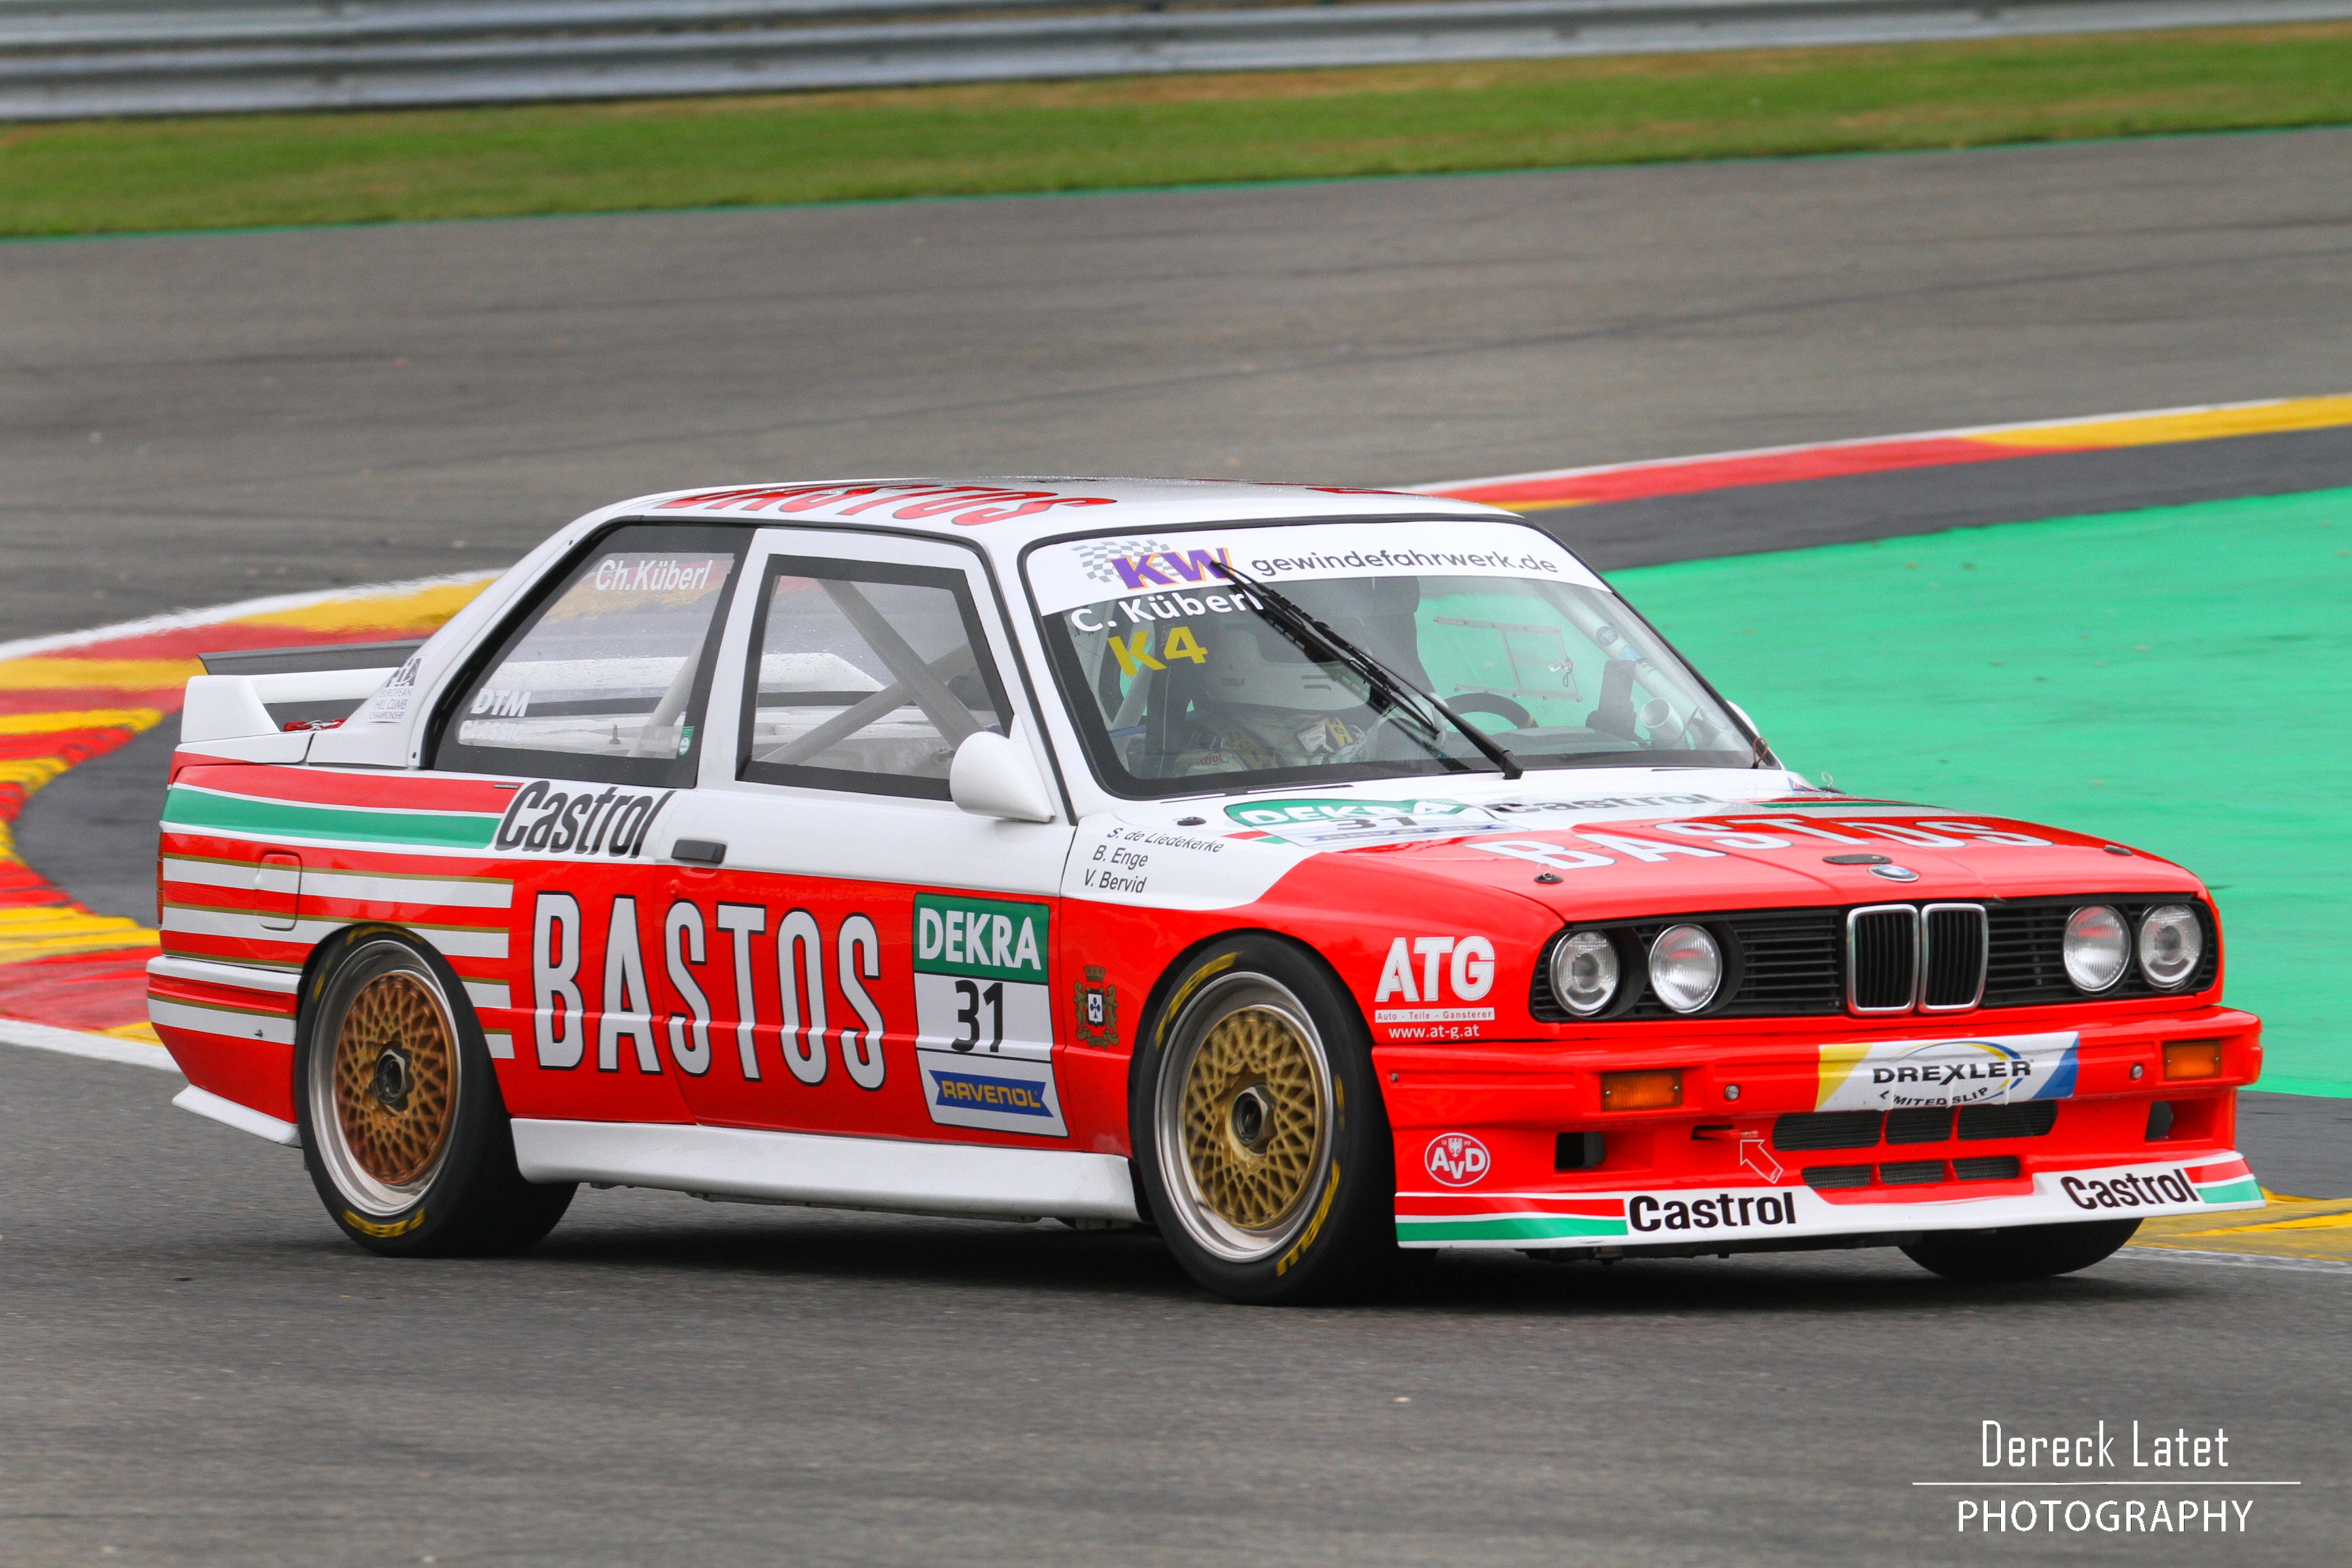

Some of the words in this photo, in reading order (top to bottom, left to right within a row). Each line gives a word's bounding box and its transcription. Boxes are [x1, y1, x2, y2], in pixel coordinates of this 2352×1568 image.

[1110, 547, 1235, 590] KW
[1251, 550, 1558, 576] gewindefahrwerk.de
[1071, 608, 1117, 632] C.
[1107, 625, 1209, 676] K4
[470, 687, 532, 717] DTM
[1239, 800, 1460, 825] DEKRA
[1484, 793, 1727, 814] Castrol
[495, 780, 673, 858] Castrol
[1328, 816, 1418, 830] 31
[1107, 827, 1123, 839] S.
[1124, 830, 1145, 841] de
[1144, 832, 1224, 853] Liedekerke
[1464, 817, 2054, 870] BASTOS
[1092, 844, 1107, 862] B.
[1111, 847, 1148, 870] Enge
[1084, 868, 1096, 887] V.
[1099, 871, 1147, 894] Bervid
[919, 907, 1041, 970] DEKRA
[1374, 936, 1495, 1002] ATG
[532, 890, 887, 1092] BASTOS
[952, 979, 1004, 1054] 31
[1409, 1011, 1430, 1019] Teile
[1443, 1011, 1492, 1019] Gansterer
[1389, 1024, 1480, 1040] www.at-g.at
[1873, 1060, 2032, 1085] DREXLER
[941, 1080, 1041, 1108] RAVENOL
[1879, 1090, 1948, 1106] LMITED
[1952, 1087, 1989, 1105] SLIP
[2060, 1169, 2200, 1210] Castrol
[1629, 1192, 1797, 1232] Castrol
